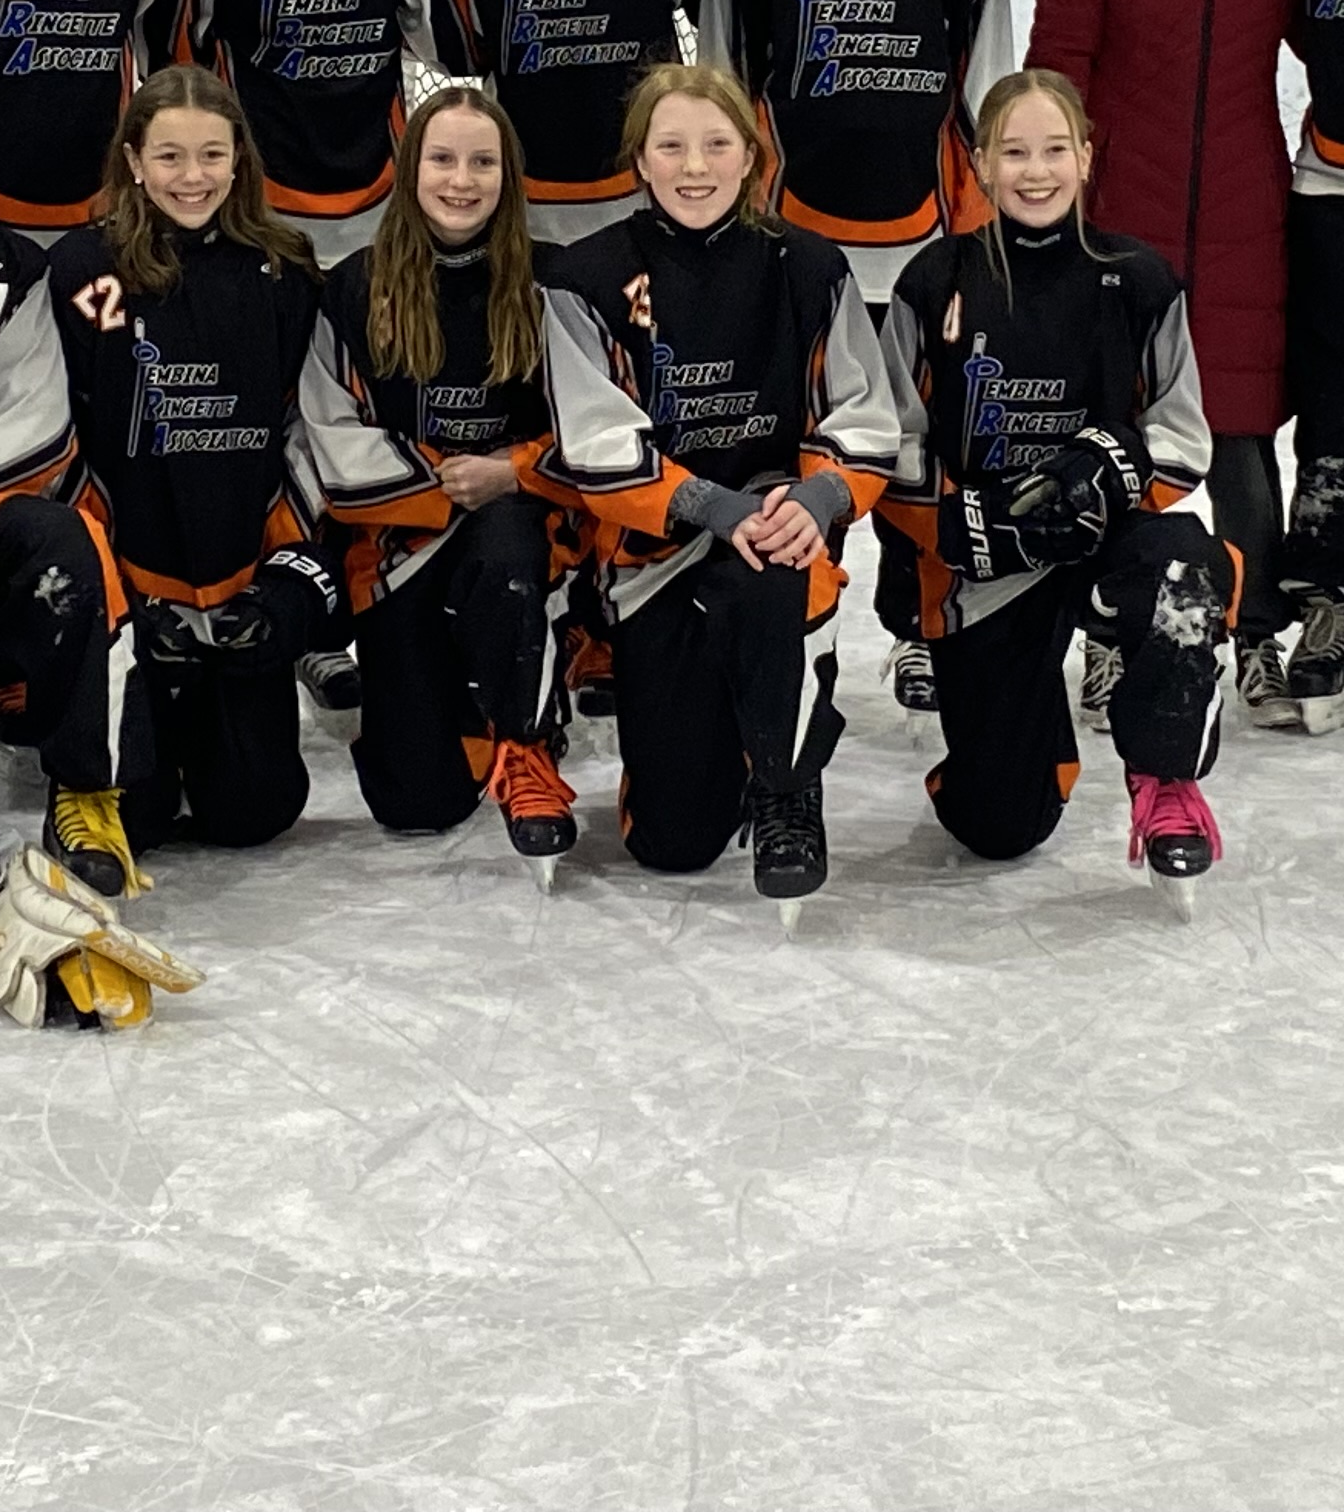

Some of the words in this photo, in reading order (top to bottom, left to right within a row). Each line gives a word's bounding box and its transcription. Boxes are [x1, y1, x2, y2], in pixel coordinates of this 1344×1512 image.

[0, 1, 120, 37] RINGETTE
[511, 13, 610, 43] RINGETTE
[518, 42, 640, 74] ASSOCIATION
[807, 26, 921, 61] RINGETTE
[810, 60, 946, 98] ASSOCIATION
